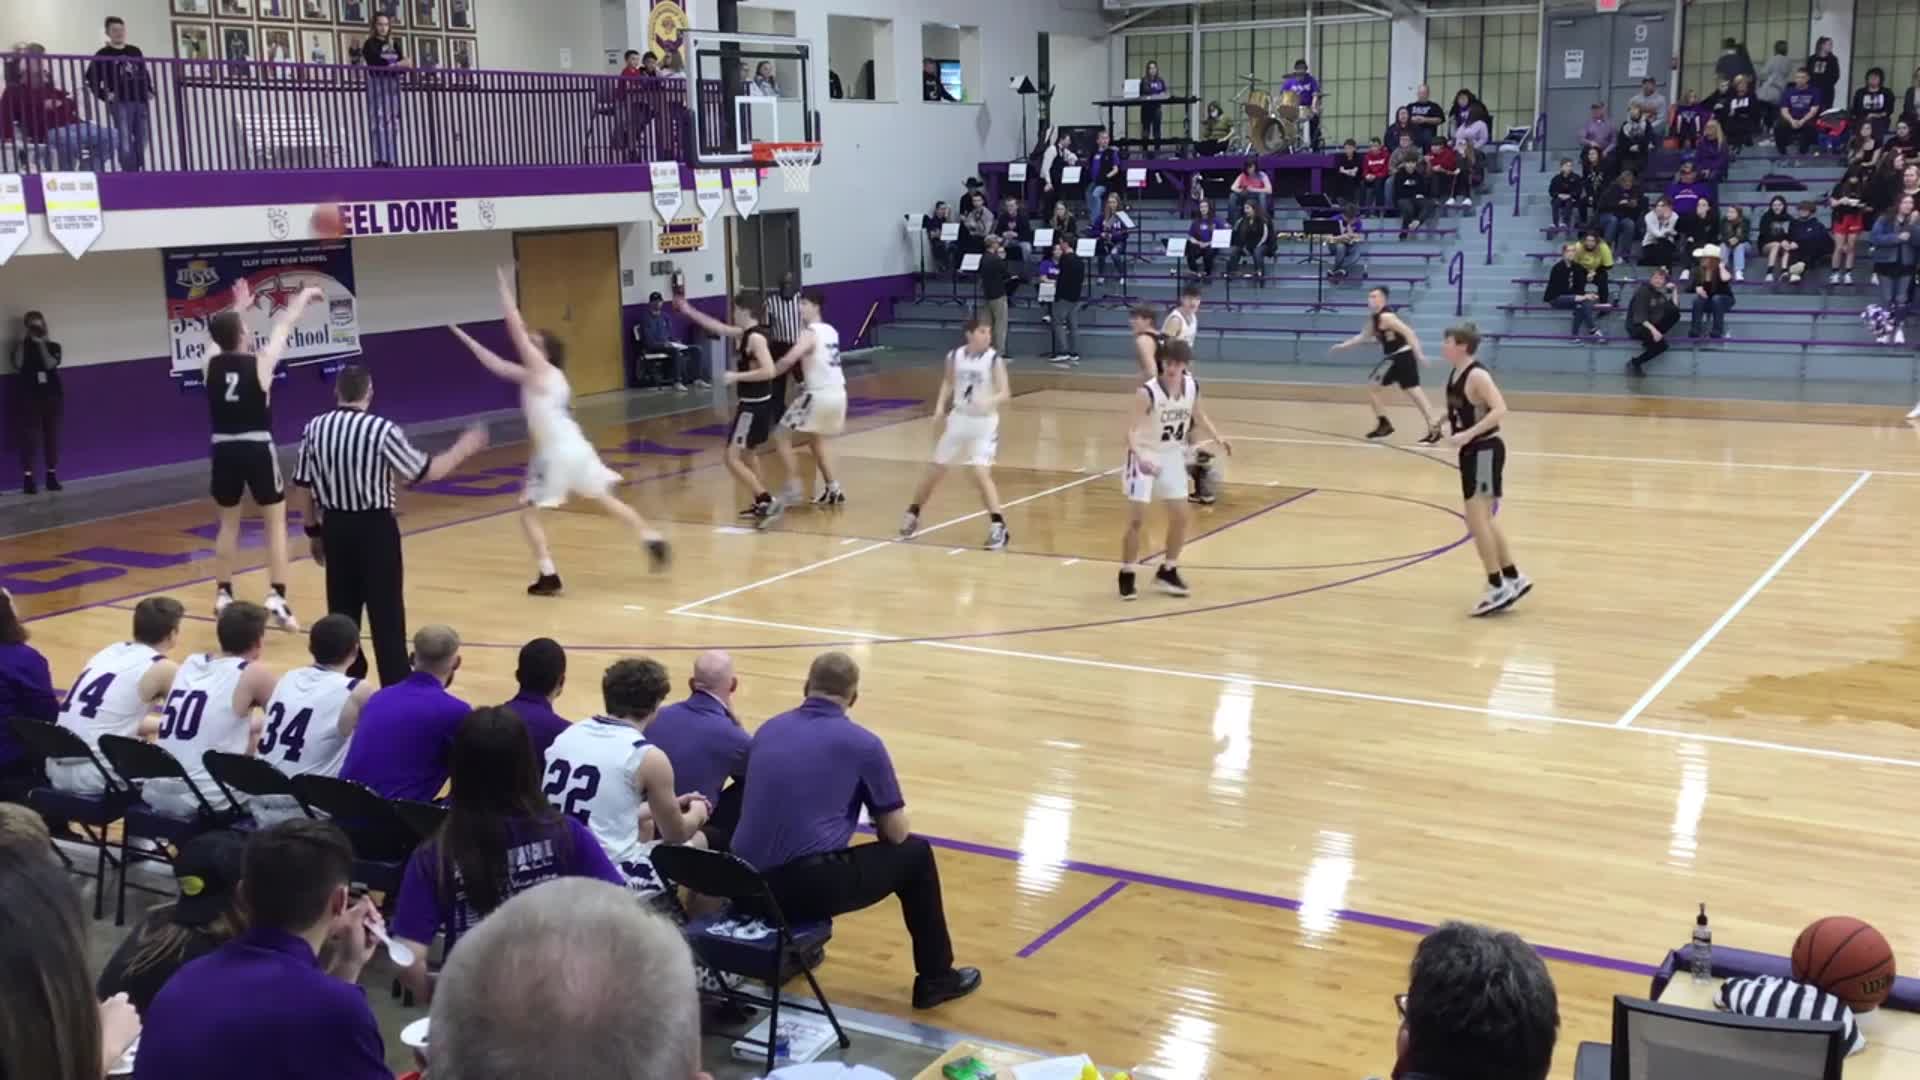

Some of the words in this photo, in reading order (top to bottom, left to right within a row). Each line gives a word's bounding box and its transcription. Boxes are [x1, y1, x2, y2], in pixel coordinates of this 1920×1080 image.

[1634, 24, 1648, 42] 9
[387, 200, 459, 233] DOME
[286, 323, 330, 349] chool
[225, 371, 240, 402] 2
[1161, 421, 1185, 441] 24
[60, 667, 117, 719] 14
[158, 689, 209, 740] 50
[257, 701, 314, 763] 34
[543, 758, 601, 827] 22
